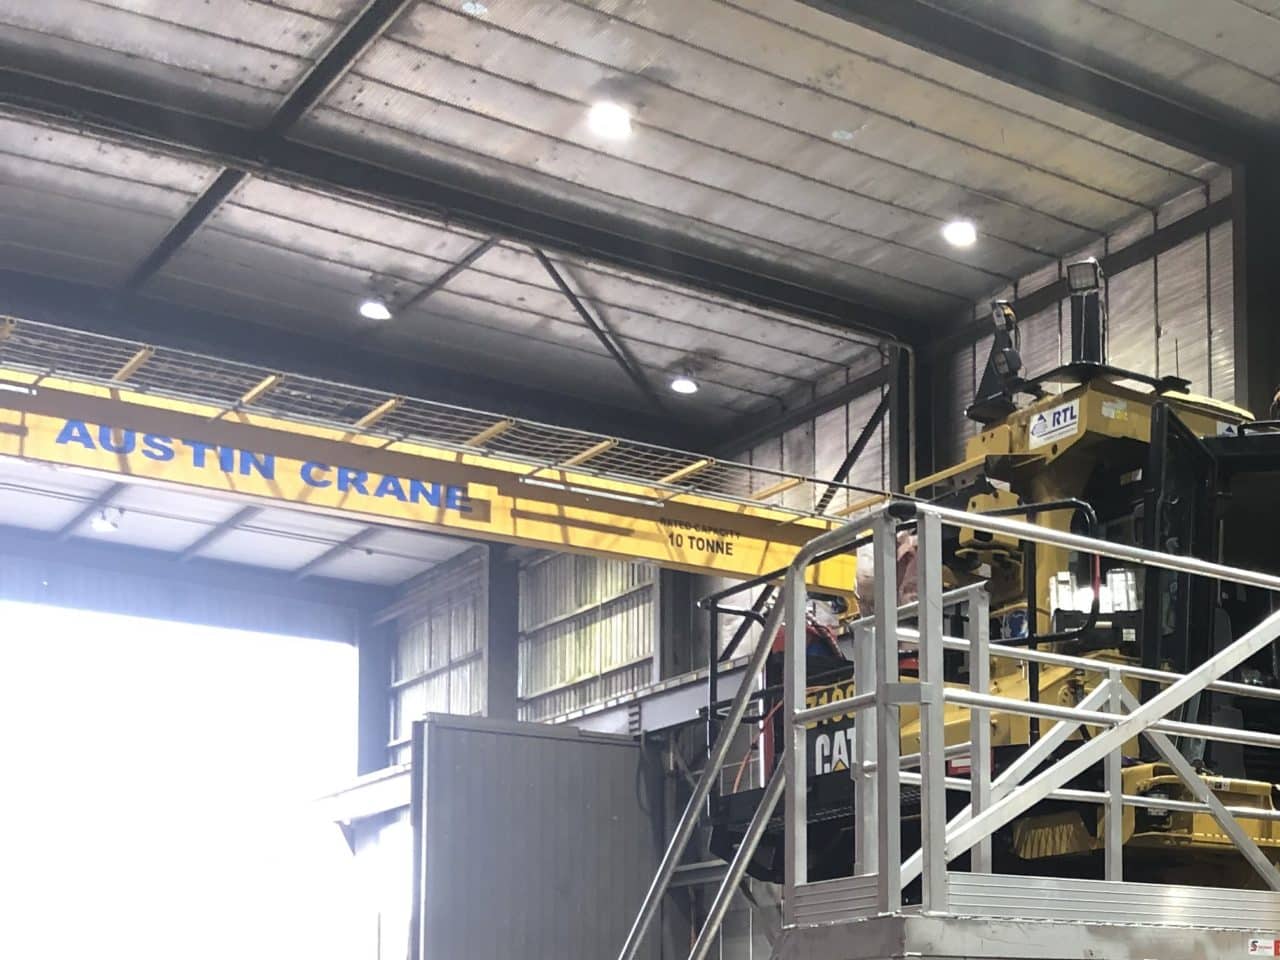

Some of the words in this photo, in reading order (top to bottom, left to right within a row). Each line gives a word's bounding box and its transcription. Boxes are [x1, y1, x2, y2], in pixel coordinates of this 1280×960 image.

[1053, 405, 1077, 427] RTL
[55, 419, 275, 480] AUSTIN
[300, 459, 473, 512] CRANE
[668, 532, 683, 548] 10
[688, 536, 733, 555] TONNE
[815, 727, 856, 775] CAT
